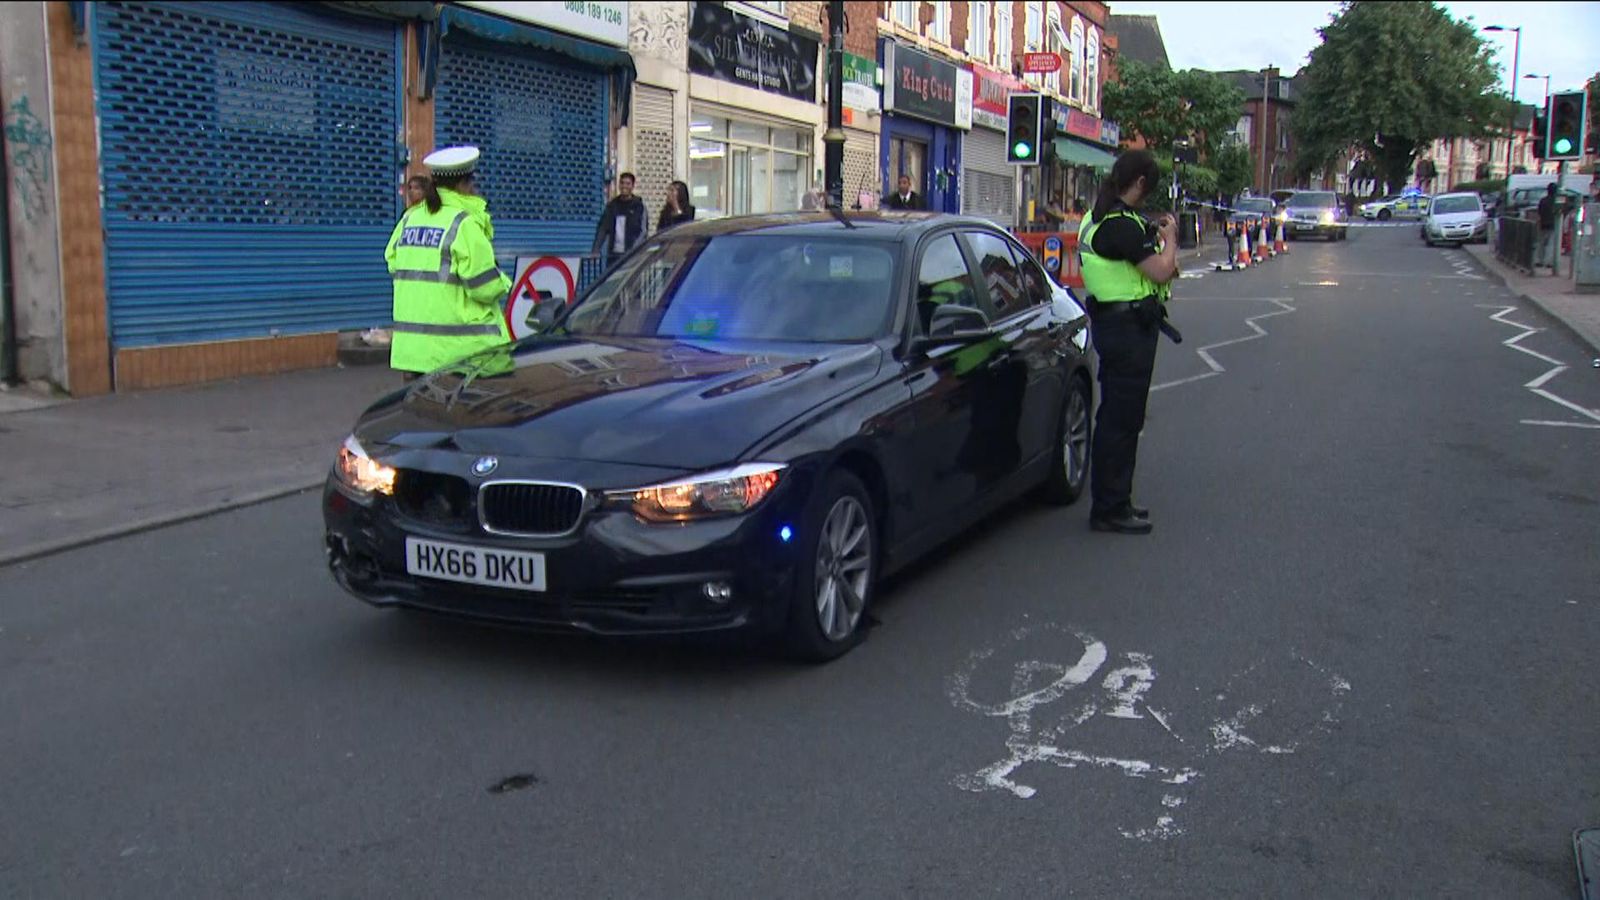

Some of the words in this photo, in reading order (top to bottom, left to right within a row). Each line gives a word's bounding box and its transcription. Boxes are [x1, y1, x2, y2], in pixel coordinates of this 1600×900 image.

[587, 3, 601, 20] 189
[604, 8, 622, 26] 1246
[735, 67, 751, 81] GENTS
[764, 74, 781, 88] STUDIO
[902, 66, 928, 101] King
[930, 75, 953, 103] Cuts
[401, 227, 442, 246] POLICE
[416, 544, 477, 578] HX66
[484, 553, 534, 586] DKU
